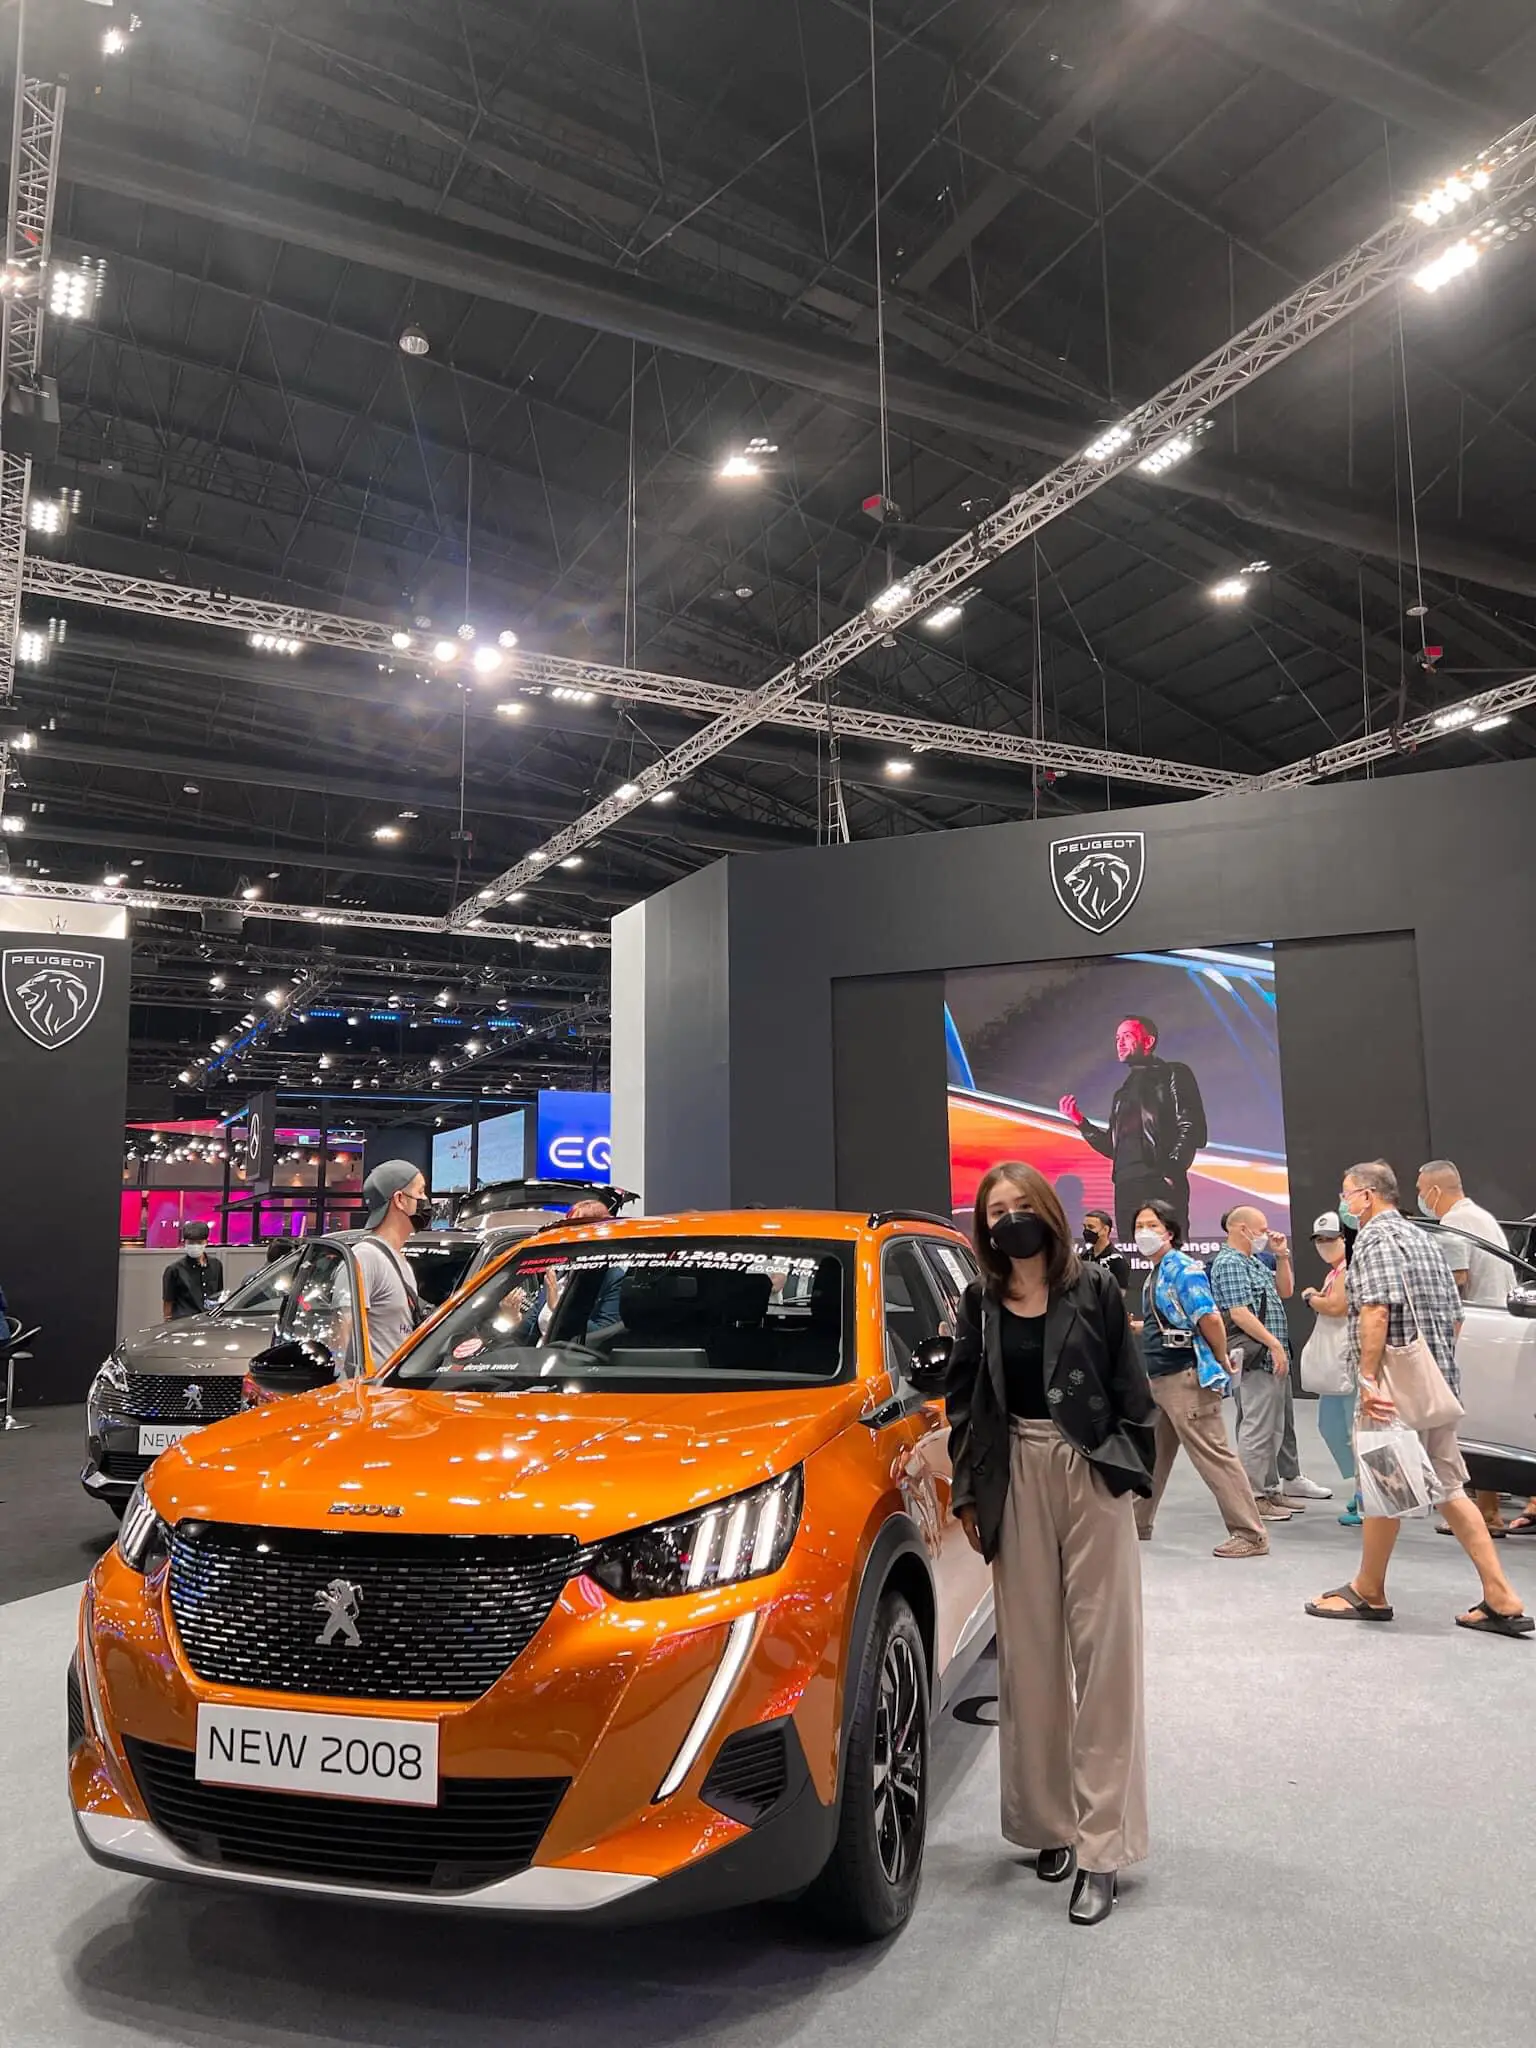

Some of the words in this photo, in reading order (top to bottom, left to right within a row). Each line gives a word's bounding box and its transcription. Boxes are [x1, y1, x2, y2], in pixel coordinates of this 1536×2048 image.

[1058, 840, 1136, 855] PEUGEOT
[11, 955, 96, 969] PEUGEOT
[634, 1250, 668, 1260] Month
[676, 1250, 768, 1264] 1,249,000
[771, 1255, 820, 1271] THB.
[648, 1259, 683, 1269] CARE
[697, 1260, 739, 1271] YEARS
[209, 1725, 308, 1769] NEW
[320, 1736, 423, 1781] 2008
